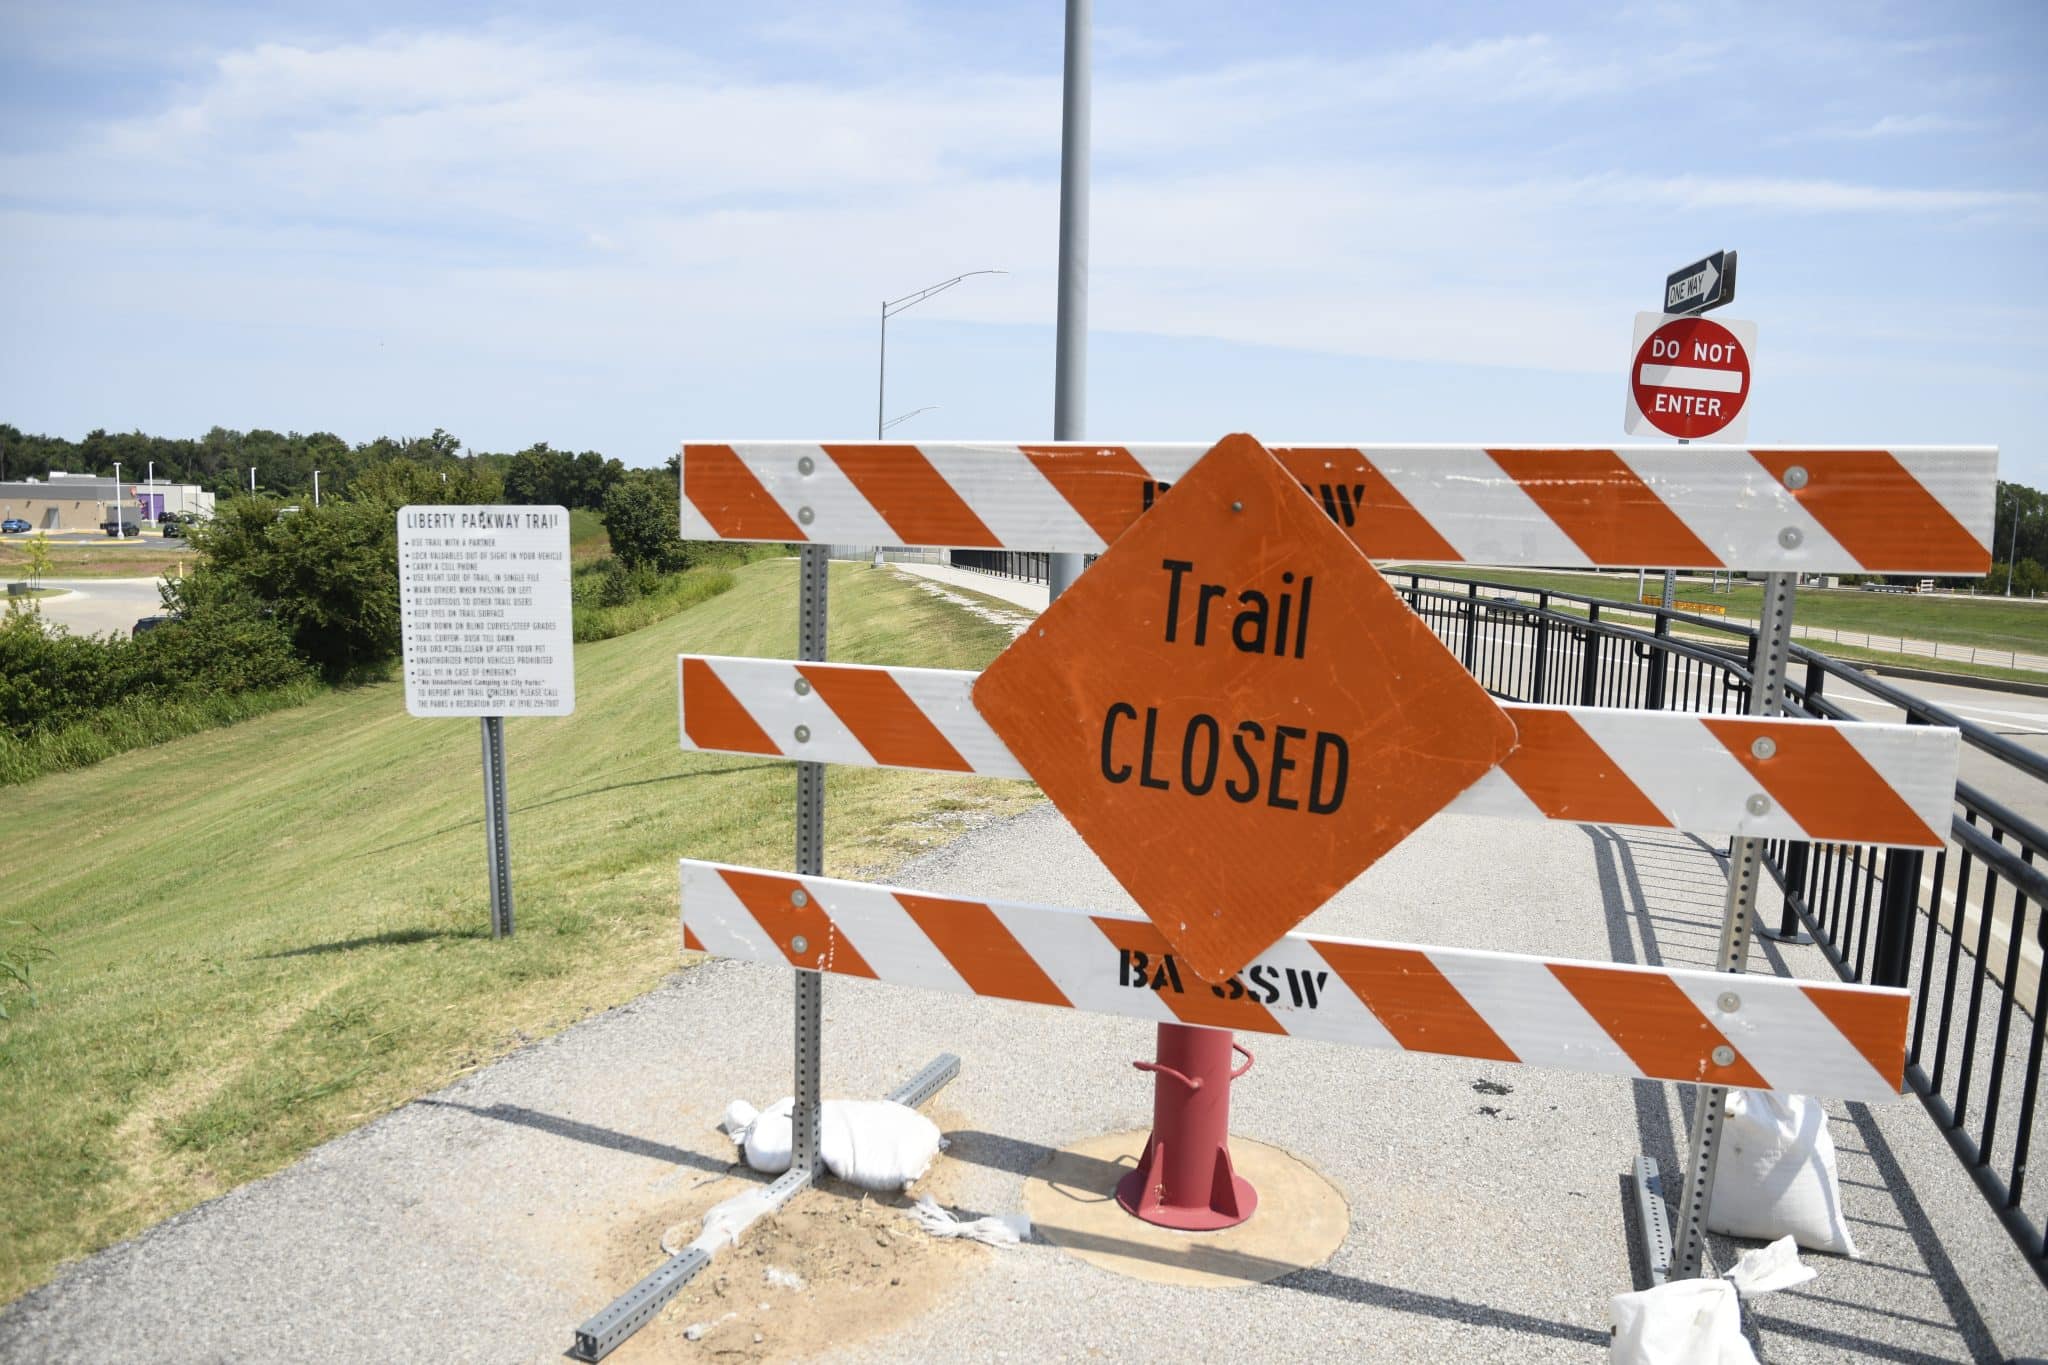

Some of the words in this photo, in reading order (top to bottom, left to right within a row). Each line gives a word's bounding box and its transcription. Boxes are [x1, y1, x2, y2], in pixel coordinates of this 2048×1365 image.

[1670, 283, 1686, 303] ONE
[1687, 273, 1705, 297] WAY
[1652, 338, 1680, 359] DO
[1694, 342, 1736, 364] NOT
[1655, 393, 1721, 417] ENTER
[407, 513, 456, 529] LIBERTY
[462, 512, 520, 529] PARKWAY
[1162, 559, 1313, 660] Trail
[1101, 702, 1349, 815] CLOSED
